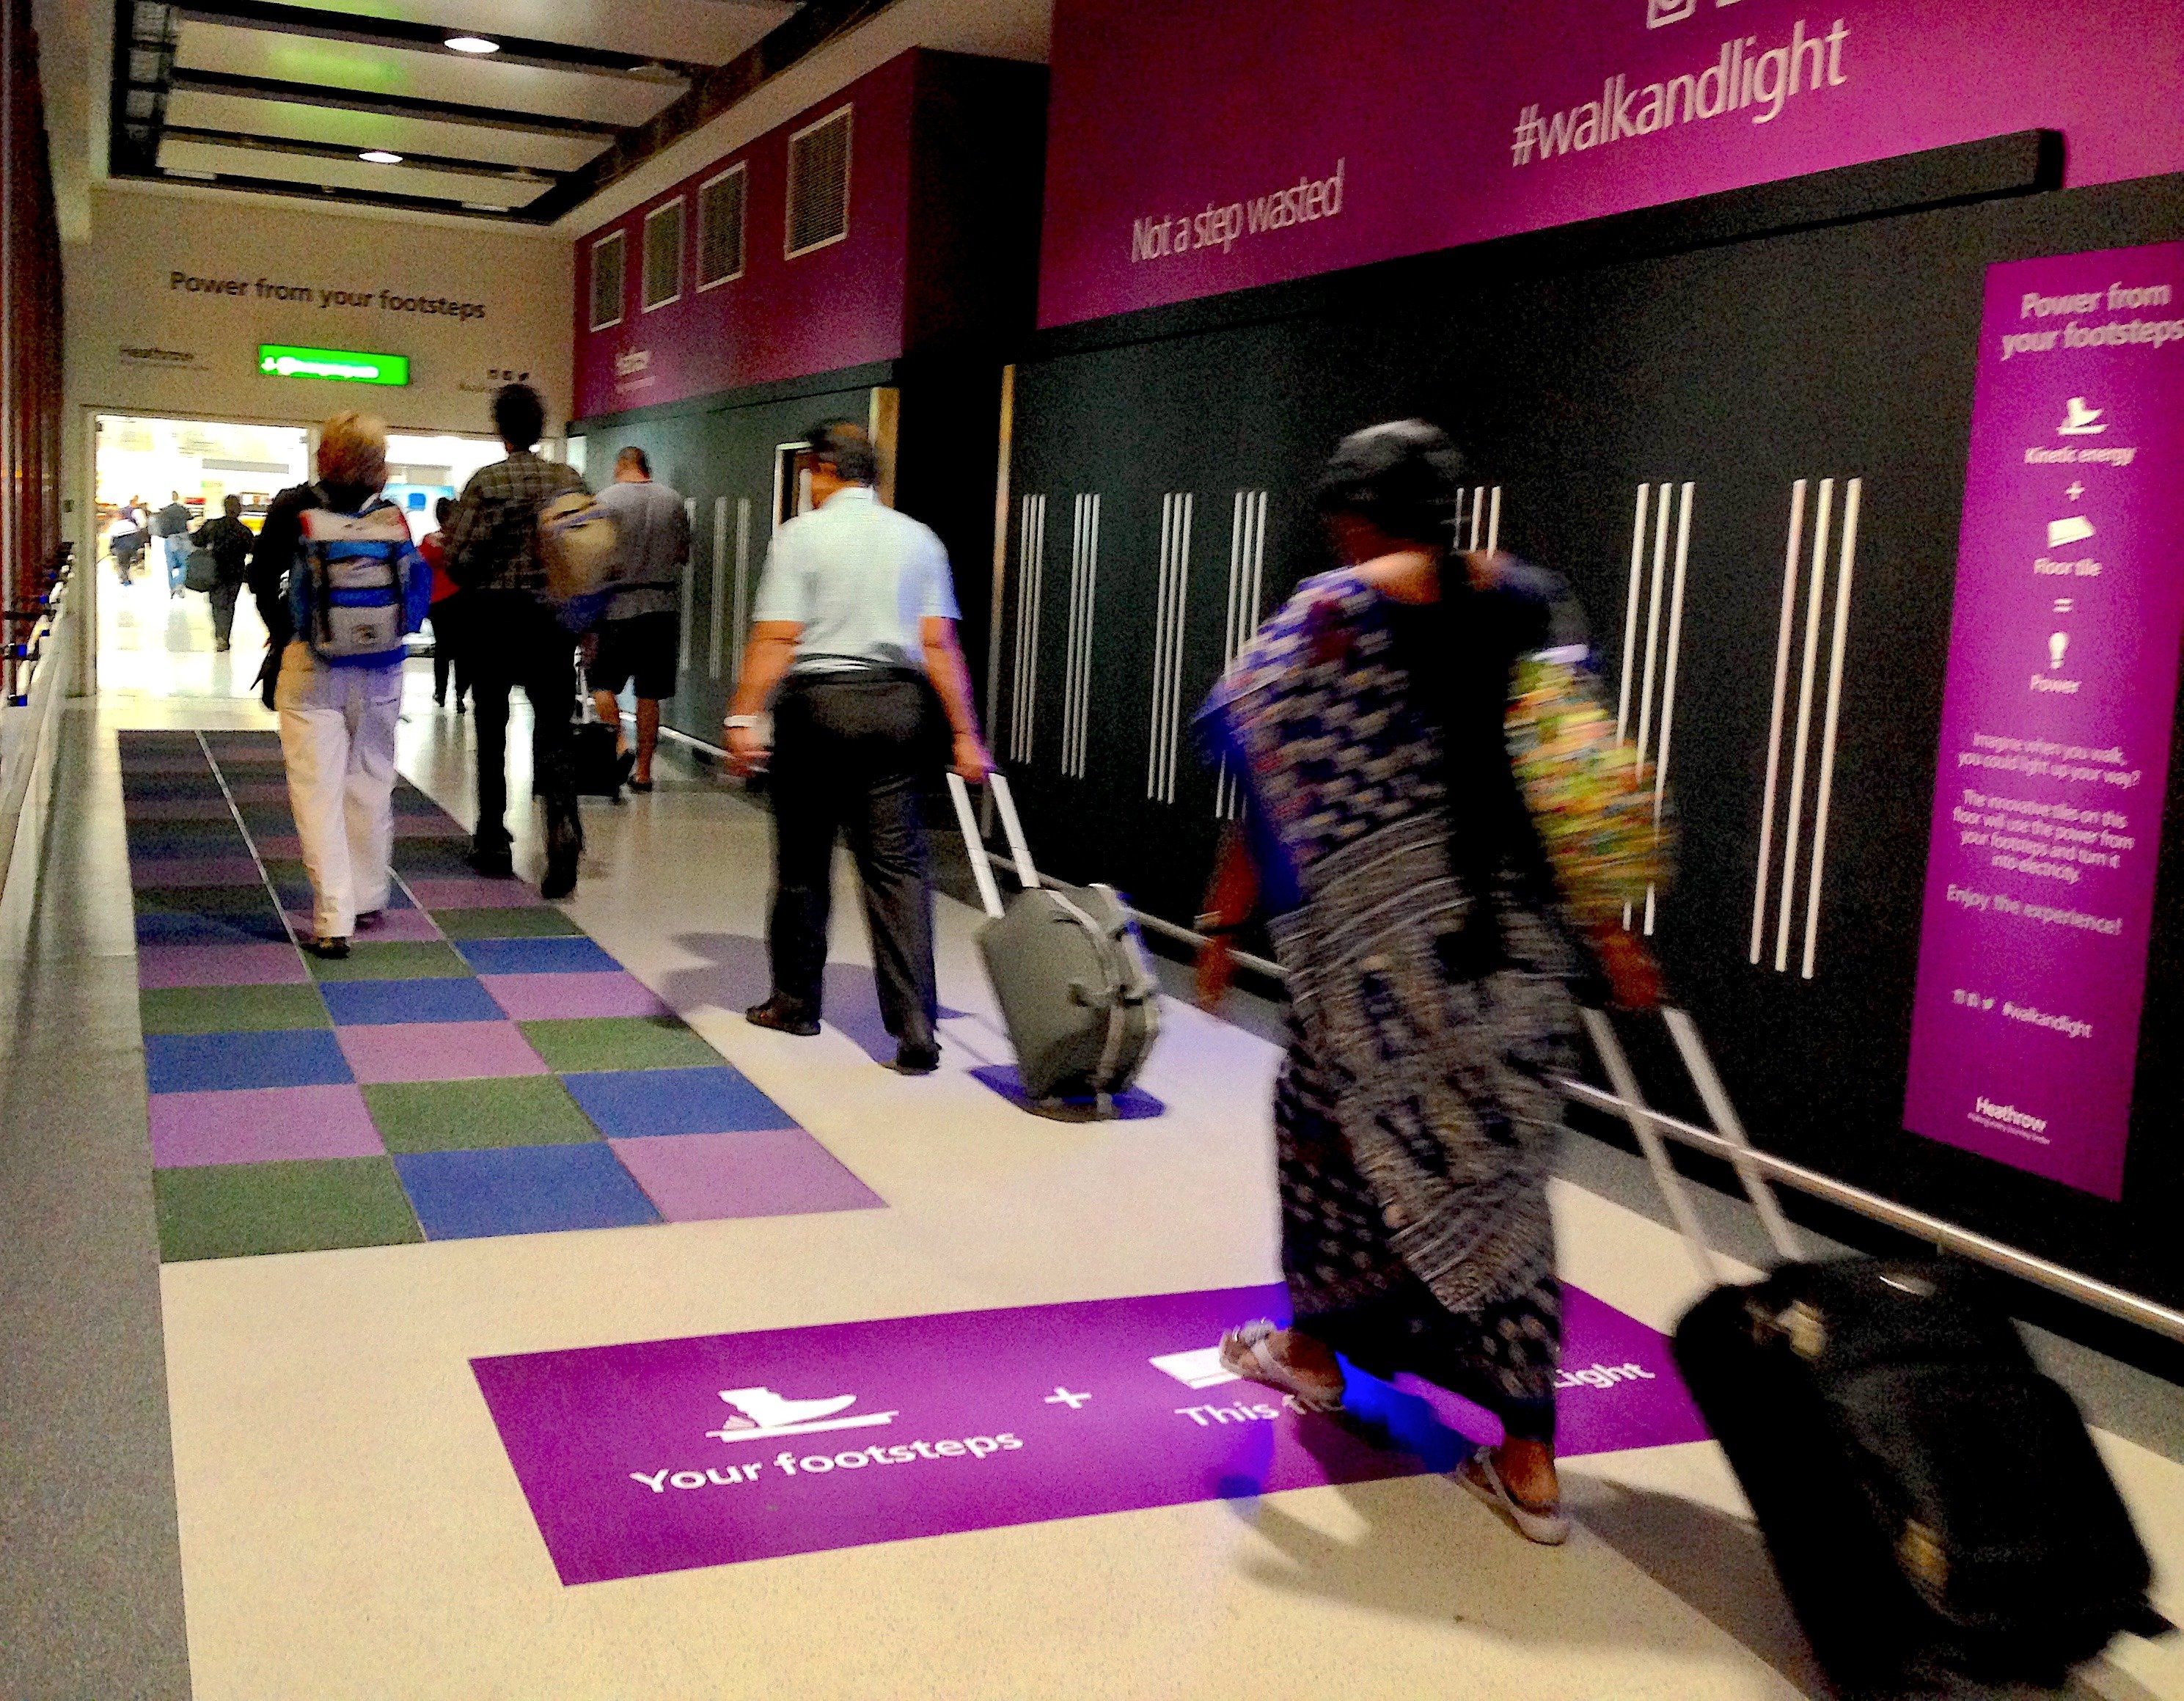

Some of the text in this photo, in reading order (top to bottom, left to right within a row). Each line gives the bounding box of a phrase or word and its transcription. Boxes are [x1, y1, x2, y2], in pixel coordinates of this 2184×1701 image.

[1511, 18, 1851, 167] #walkandlight
[1131, 157, 1345, 263] Not a step wasted
[170, 271, 485, 321] Power from your footsteps
[2020, 281, 2172, 319] Power from
[2001, 320, 2184, 362] your footsteps
[1946, 883, 1990, 910] Enjoy
[1976, 1095, 2048, 1133] Heathrow
[1174, 1401, 1280, 1426] This
[629, 1431, 1024, 1493] Your footsteps
